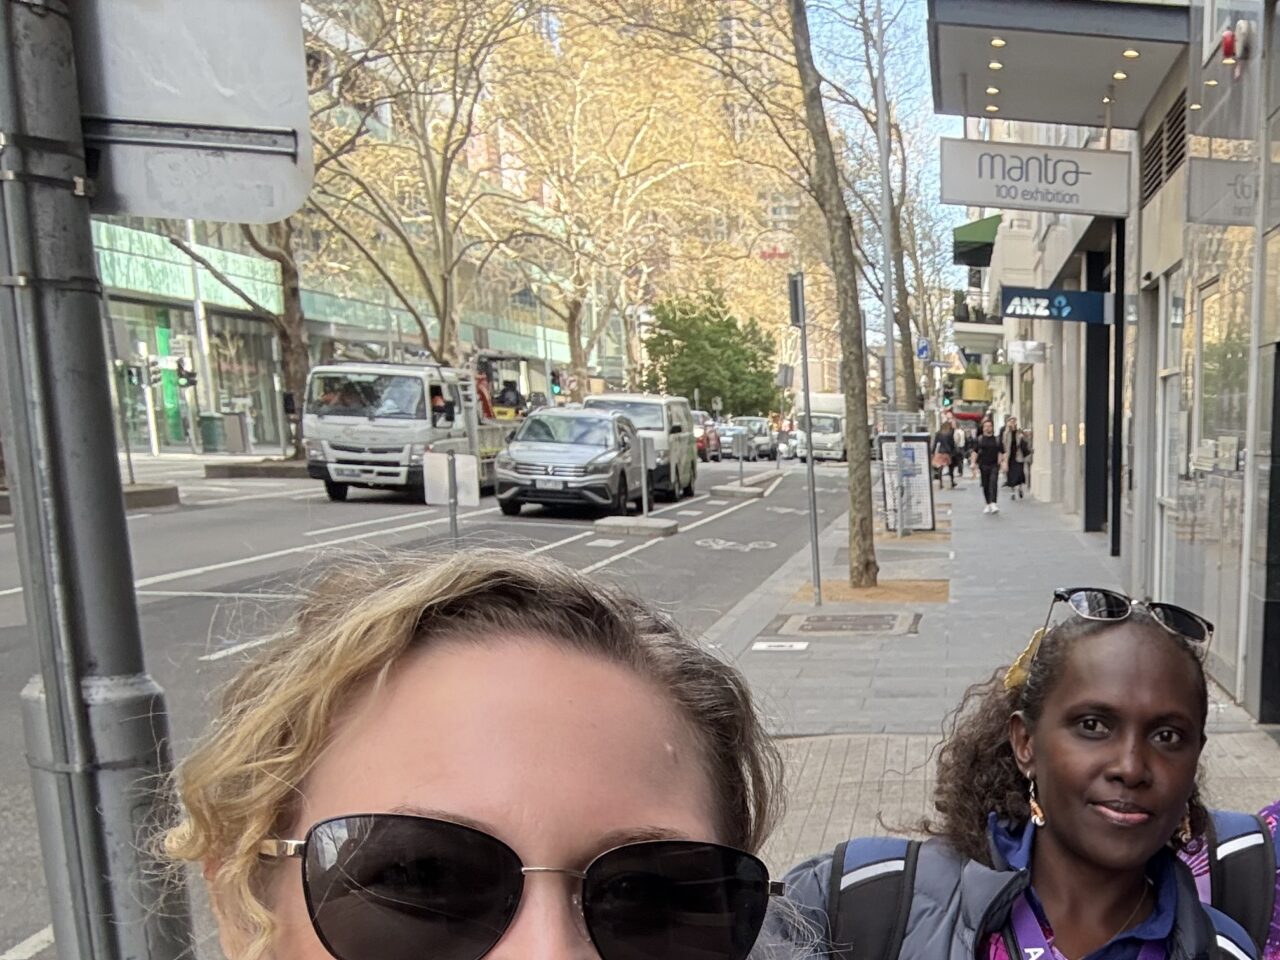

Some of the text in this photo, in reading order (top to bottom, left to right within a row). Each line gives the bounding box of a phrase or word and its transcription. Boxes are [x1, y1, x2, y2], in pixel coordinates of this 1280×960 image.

[978, 152, 1092, 187] mantra
[995, 184, 1079, 205] 100 exhibition
[1005, 297, 1050, 317] ANZ
